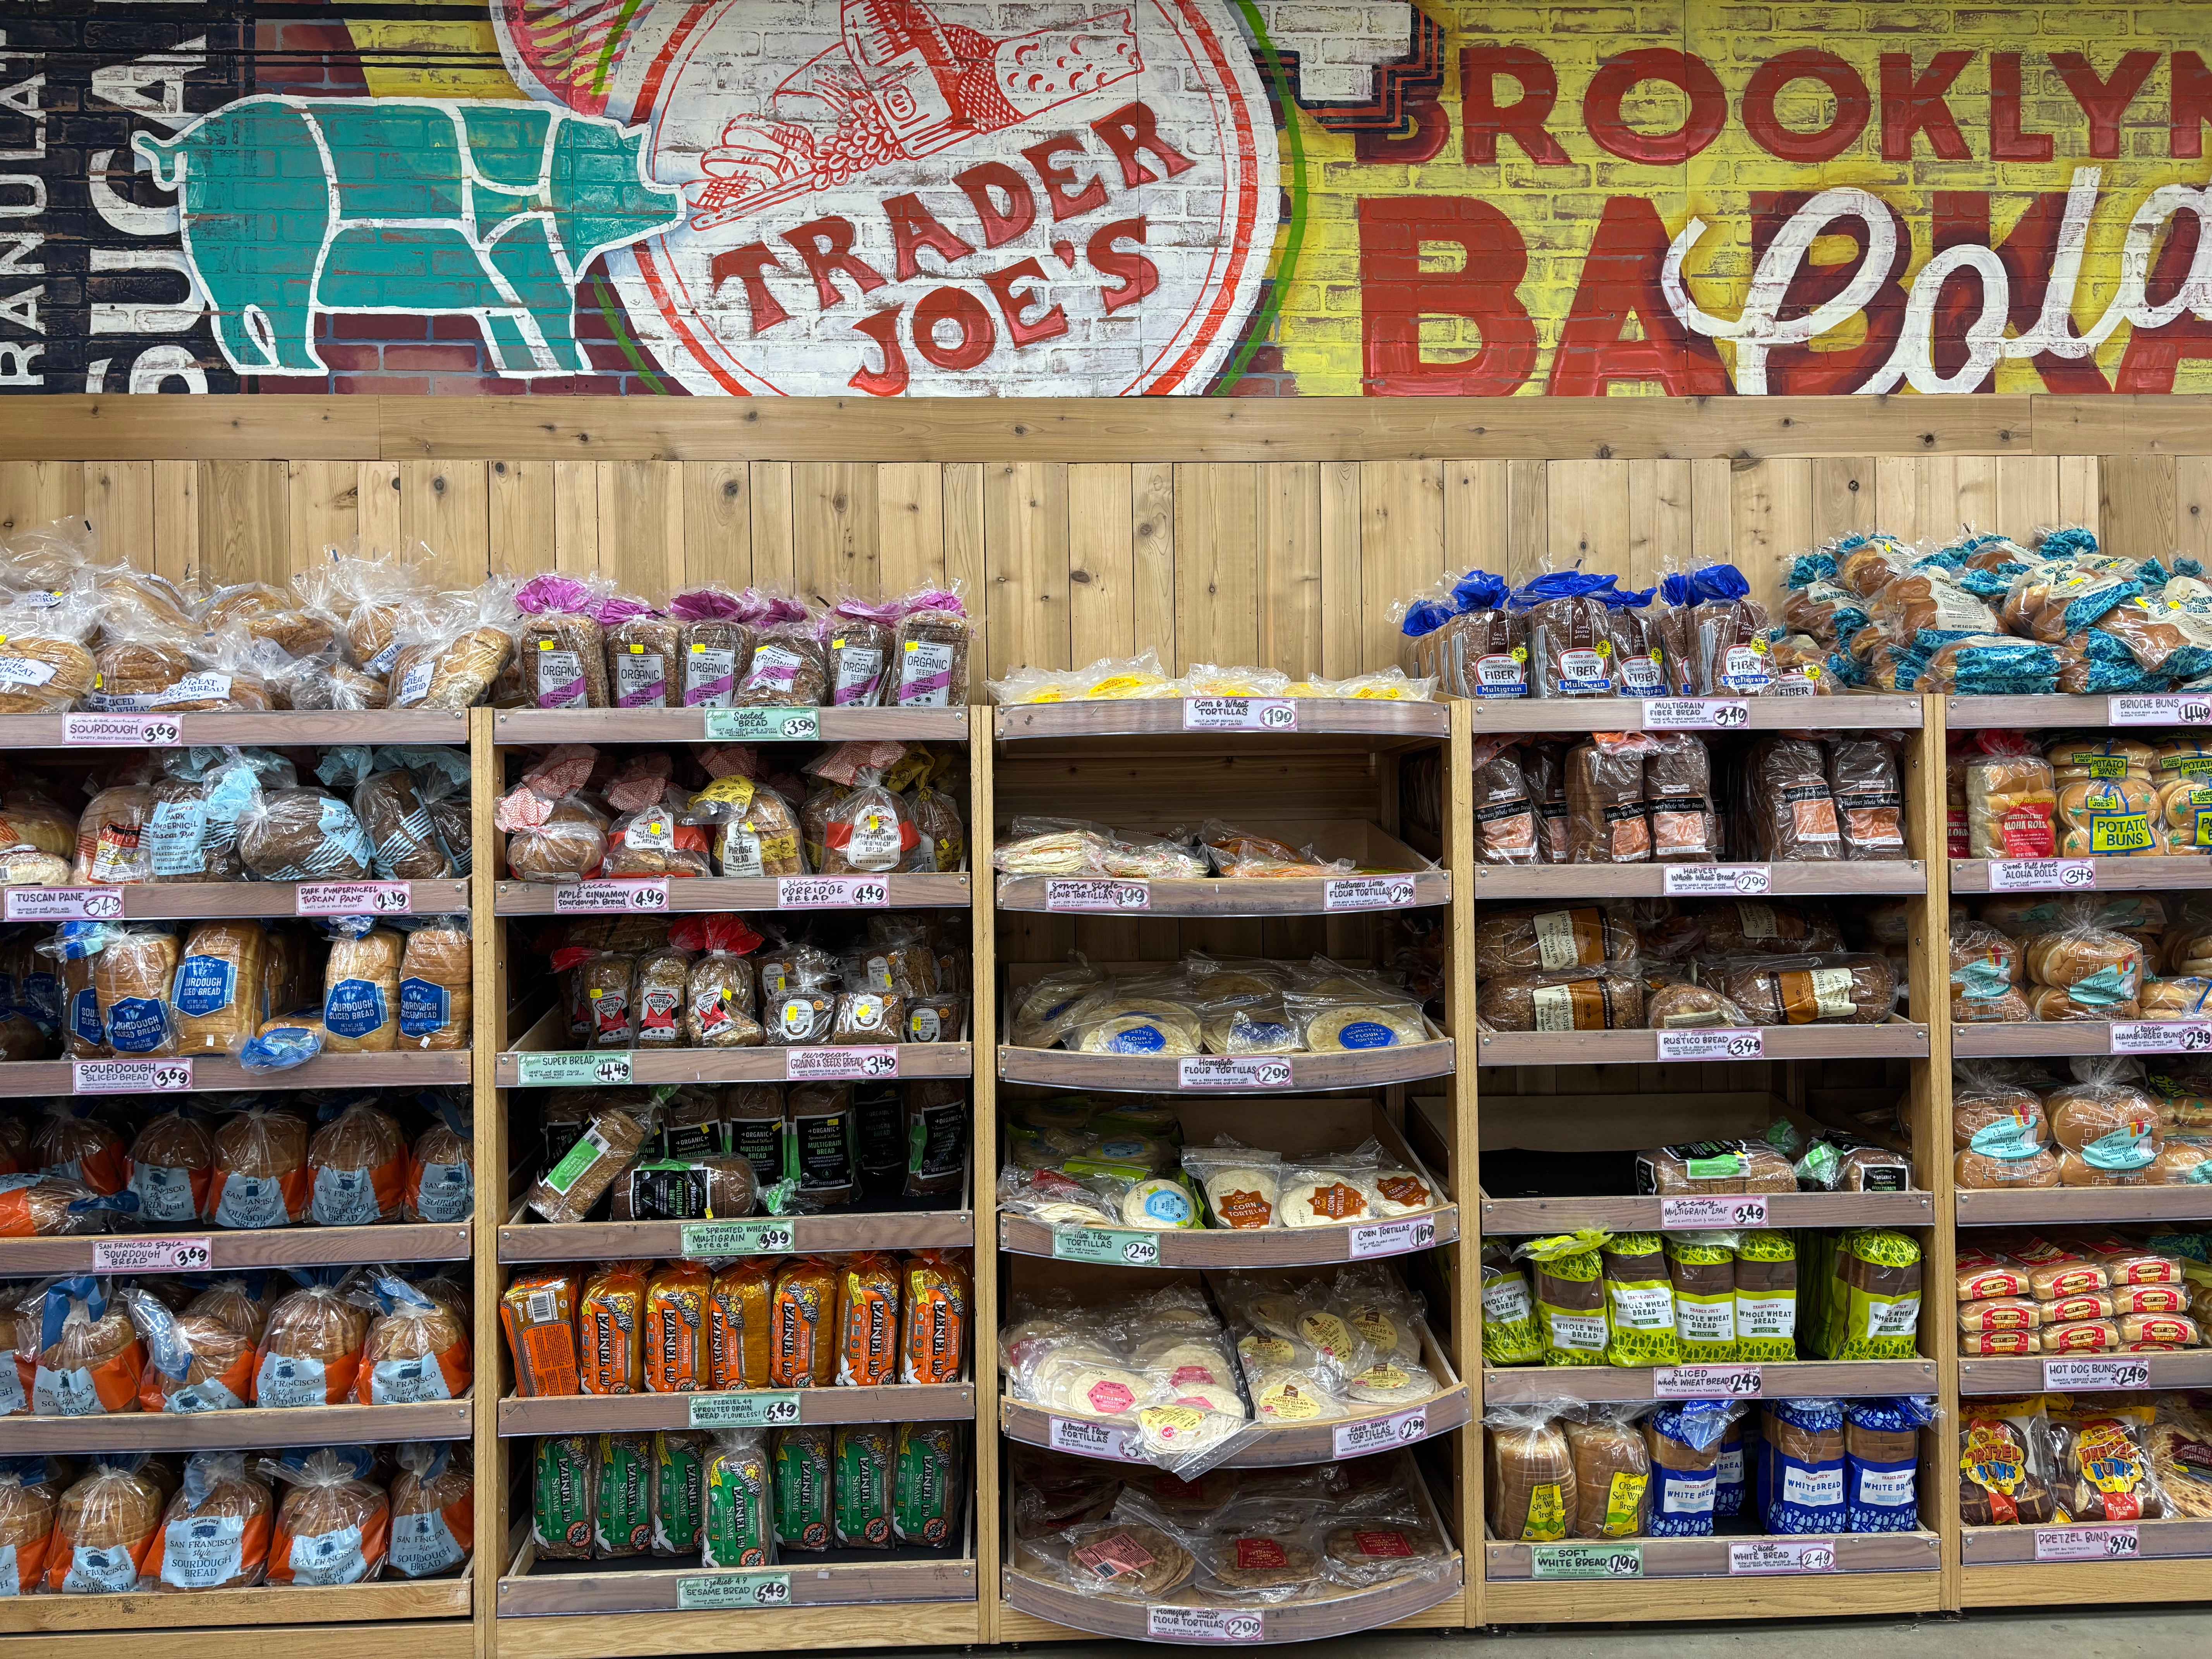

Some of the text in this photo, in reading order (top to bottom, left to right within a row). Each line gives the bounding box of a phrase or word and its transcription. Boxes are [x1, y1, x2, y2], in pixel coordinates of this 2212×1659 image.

[711, 102, 1197, 335] TRADER
[848, 217, 1161, 397] JOE'S
[690, 662, 729, 674] ORGANIC
[907, 657, 947, 670] ORGANIC
[1485, 670, 1515, 680] FIBER
[1195, 699, 1249, 708] Corn Wheat
[2120, 698, 2179, 708] BRIOCHE BUNS
[734, 712, 766, 721] Seeded
[1199, 708, 1248, 716] TORTILLAS
[70, 724, 138, 734] SOURDOUGH
[145, 723, 177, 742] 3.69
[2097, 819, 2147, 833] POTATO
[2106, 833, 2143, 846] BUNS
[2006, 869, 2057, 879] ALOHA ROLLS
[782, 886, 843, 895] PORRIDGE
[1334, 881, 1365, 890] Habanero
[16, 892, 84, 902] TUSCAN PANE
[586, 891, 630, 899] CINNAMON
[635, 890, 665, 906] 4.99
[856, 885, 884, 902] 4.49
[1049, 890, 1114, 900] FLOUR TORTILLAS
[1329, 888, 1390, 898] FLOUR TORTILLAS
[340, 895, 364, 903] PANE
[352, 1010, 374, 1019] BREAD
[802, 1051, 851, 1060] european
[543, 1056, 595, 1066] SUPER BREAD
[791, 1058, 815, 1069] GRAINS
[822, 1058, 842, 1068] SEEDS
[843, 1057, 863, 1067] BREAD
[1199, 1058, 1235, 1067] Homestyle
[81, 1063, 156, 1075] SOURDOUGH
[1216, 1066, 1256, 1074] TORTILLAS
[157, 1068, 187, 1086] 3.69
[2103, 1139, 2125, 1148] Classic
[1233, 1202, 1257, 1210] CORN
[1336, 1188, 1345, 1216] TORTILLAS
[1228, 1207, 1267, 1217] TORTILLAS
[1665, 1207, 1707, 1216] MULTIGRAIN
[1735, 1207, 1764, 1223] 3.49
[706, 1226, 743, 1234] SPROUTED
[1075, 1231, 1089, 1239] Mini
[1358, 1224, 1410, 1240] CORN TORTILLAS
[693, 1233, 745, 1243] MULTIGRAIN
[155, 1241, 184, 1251] style
[1065, 1238, 1112, 1249] TORTILLAS
[104, 1250, 160, 1259] SOURDOUGH
[177, 1248, 207, 1266] 3.69
[2050, 1364, 2117, 1374] HOT DOG BUNS
[1062, 1422, 1110, 1436] Almond Flour
[1370, 1420, 1389, 1429] SAVVY
[1061, 1430, 1108, 1443] TORTILLAS
[1348, 1426, 1390, 1441] TORTILLAS
[2081, 1441, 2138, 1469] PRETZEL
[2090, 1458, 2134, 1479] BUNS
[1788, 1479, 1840, 1492] WHITE BREAD
[551, 1477, 560, 1513] SESAME
[188, 1537, 238, 1548] FRANCISCO
[2039, 1532, 2109, 1544] PRETZEL BUNS
[1752, 1544, 1777, 1553] Sliced
[172, 1556, 232, 1568] SOURDOUGH
[410, 1560, 441, 1571] BREAD
[1538, 1558, 1606, 1566] WHITE BREAD
[185, 1569, 217, 1577] BREAD
[687, 1587, 750, 1596] SESAME BREAD
[1153, 1616, 1223, 1628] FLOUR TORTILLAS
